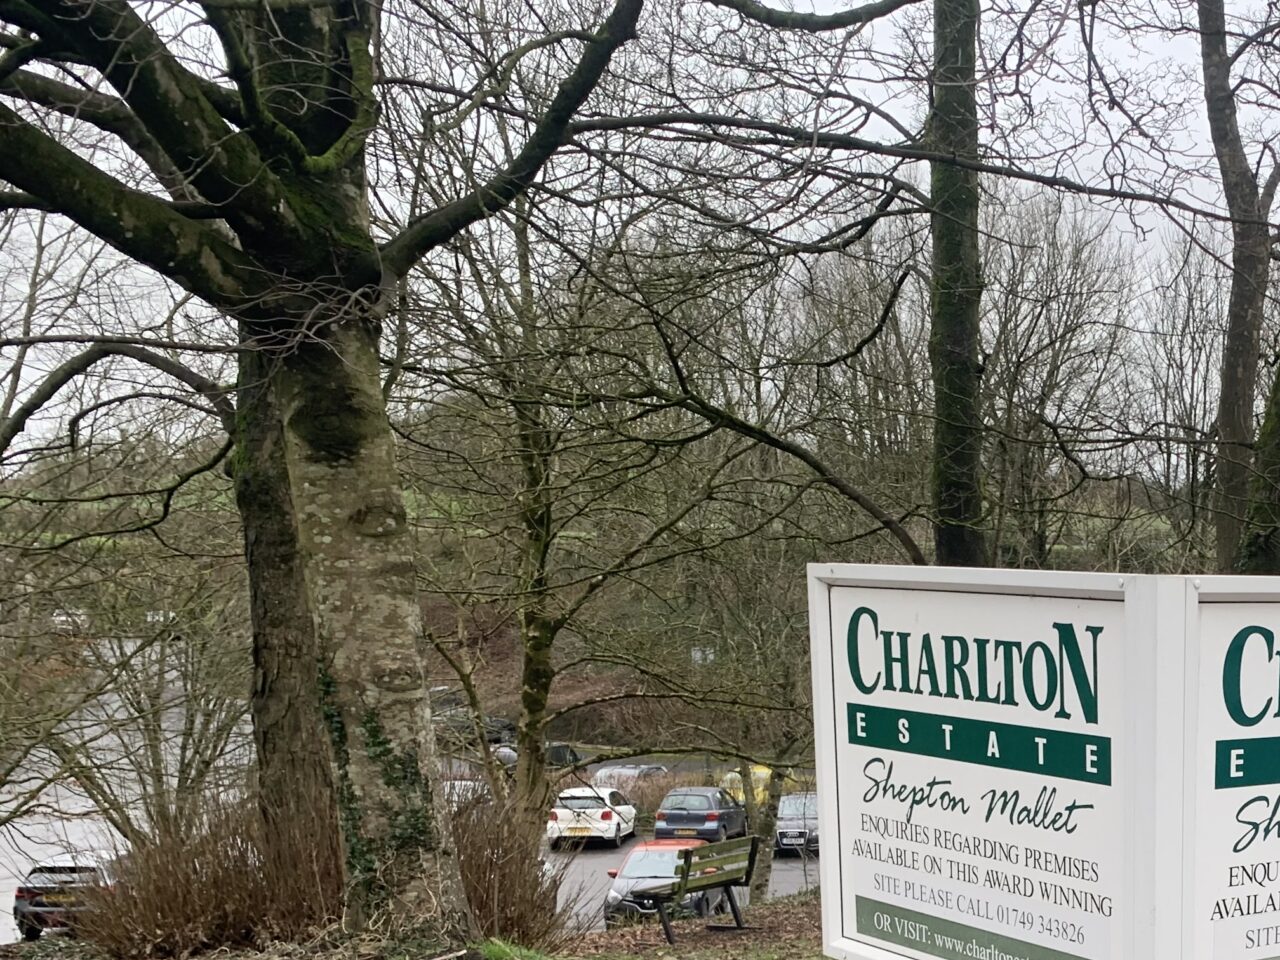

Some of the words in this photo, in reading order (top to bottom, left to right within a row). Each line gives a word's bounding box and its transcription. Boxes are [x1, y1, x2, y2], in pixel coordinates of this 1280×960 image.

[847, 606, 1104, 724] CHARLTON
[856, 712, 1098, 774] ESTATE
[862, 757, 971, 824] Shepton
[980, 784, 1094, 834] Mallet
[852, 839, 919, 870] AVAILABLE
[923, 856, 944, 877] ON
[947, 862, 979, 885] THIS
[984, 871, 1034, 899] AWARD
[1038, 882, 1113, 918] WINNING
[861, 814, 929, 846] ENQUIRIES
[934, 830, 1019, 865] REGARDING
[1024, 848, 1099, 883] PREMISES
[874, 874, 900, 895] SITE
[904, 881, 954, 911] PLEASE
[957, 895, 994, 921] CALL
[997, 905, 1034, 931] 01749
[1038, 916, 1085, 945] 343826
[874, 911, 893, 934] OR
[895, 916, 931, 946] VISIT:
